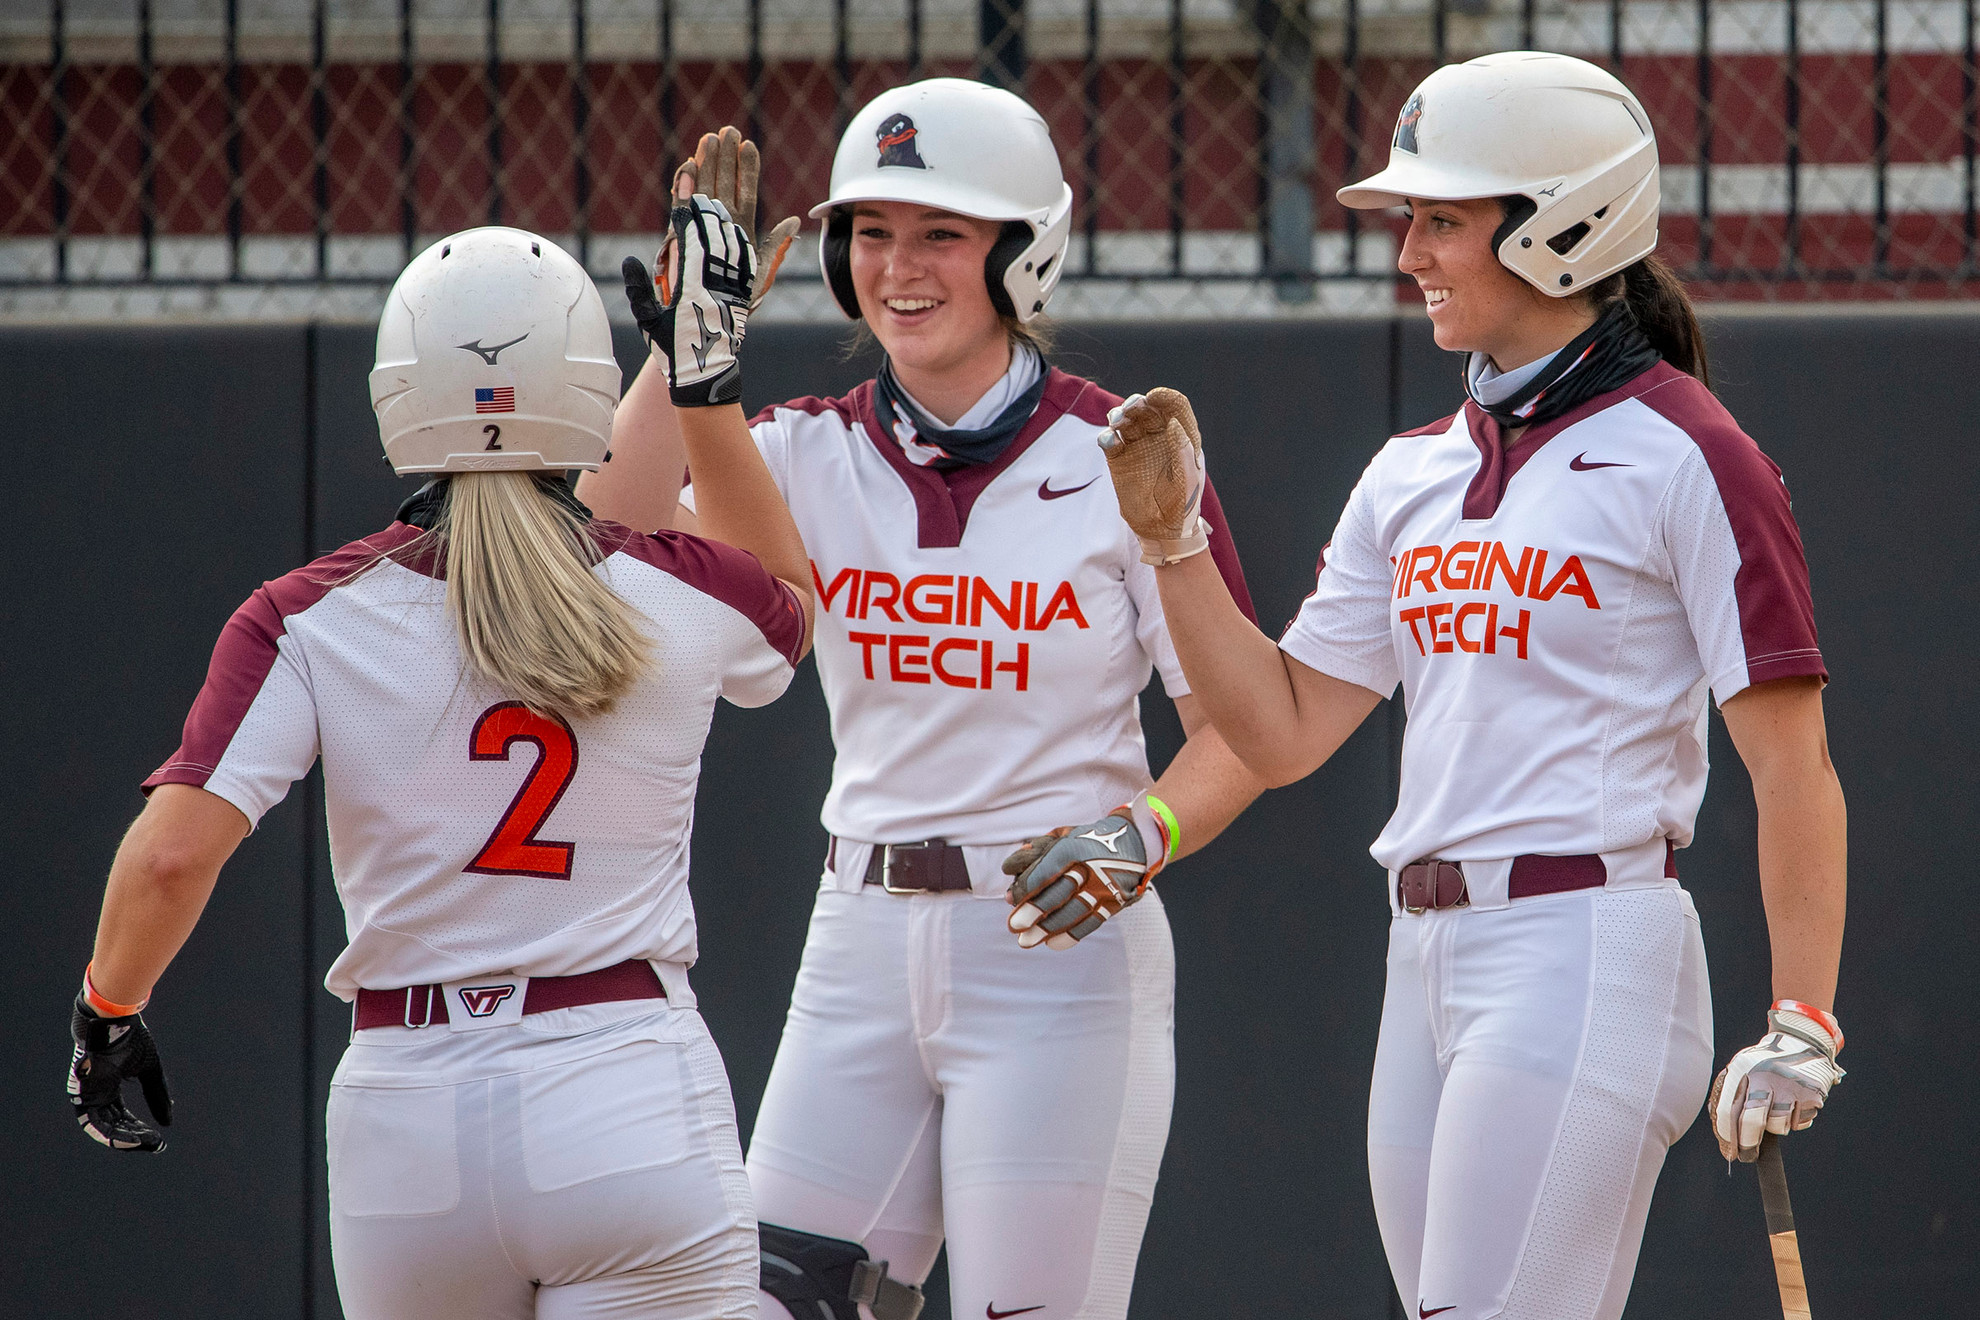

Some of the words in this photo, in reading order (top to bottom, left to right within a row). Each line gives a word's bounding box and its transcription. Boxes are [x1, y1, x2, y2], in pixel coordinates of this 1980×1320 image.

[483, 424, 502, 451] 2
[809, 559, 1090, 631] VIRGINIA
[848, 631, 1029, 692] TECH
[1399, 602, 1531, 660] TECH
[461, 700, 579, 881] 2
